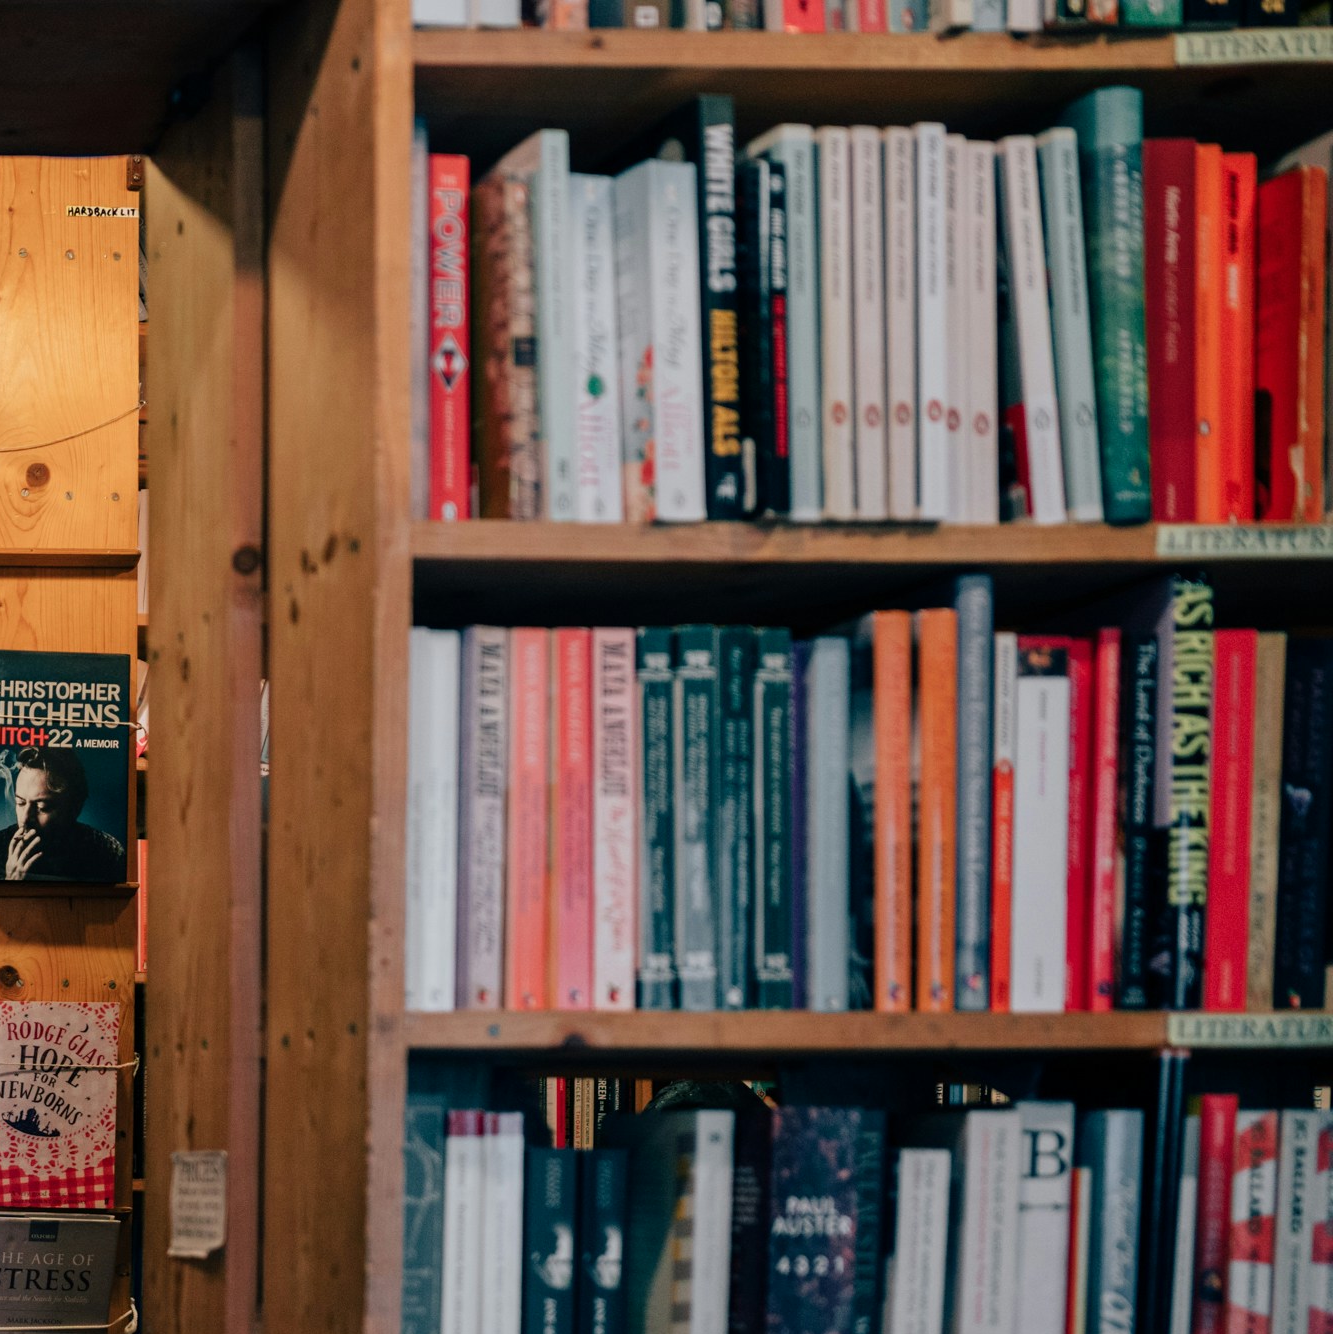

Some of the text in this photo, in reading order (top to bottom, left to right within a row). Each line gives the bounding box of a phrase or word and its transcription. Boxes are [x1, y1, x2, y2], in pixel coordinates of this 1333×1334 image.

[68, 207, 118, 216] HARDBACK
[703, 122, 736, 293] WHITE GIRLS
[434, 187, 463, 329] POWER
[710, 309, 740, 457] HILTON ALS
[76, 739, 82, 748] A
[83, 739, 119, 749] MEMOIR
[1133, 643, 1157, 824] The Land of Darkness
[1167, 582, 1213, 906] AS RICH AS THE KING
[7, 1021, 113, 1075] RODGE GLASS
[19, 1044, 88, 1088] HOPE
[33, 1072, 57, 1087] FOR
[1021, 1128, 1068, 1179] B
[771, 1214, 853, 1237] AUSTER
[786, 1195, 836, 1215] PAUL
[32, 1253, 65, 1265] AGE
[73, 1254, 95, 1266] OF
